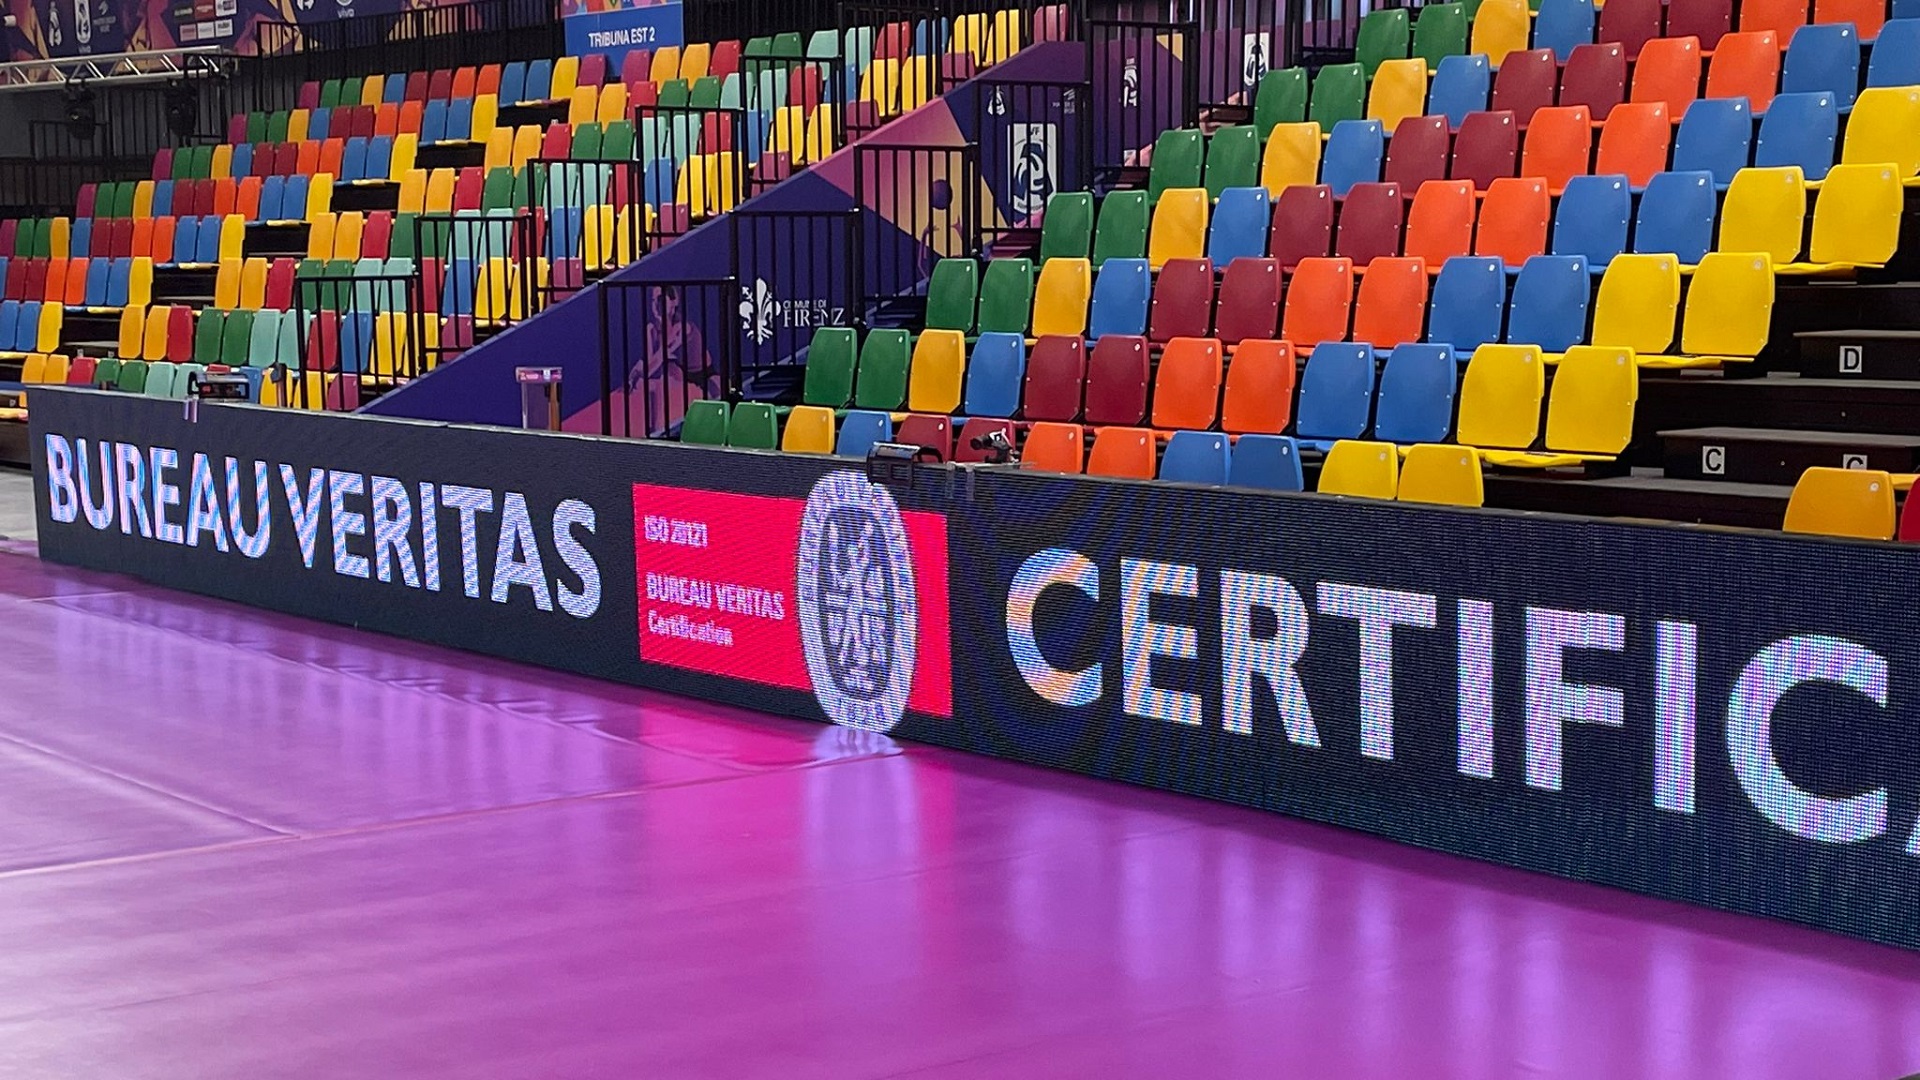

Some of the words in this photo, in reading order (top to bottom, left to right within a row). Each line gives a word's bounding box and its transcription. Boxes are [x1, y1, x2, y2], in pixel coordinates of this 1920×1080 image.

[588, 29, 630, 47] TRIBUNA
[631, 27, 648, 43] EST
[649, 26, 655, 42] 2
[783, 307, 846, 327] FIRENZ
[1843, 348, 1860, 370] D
[1705, 448, 1722, 472] C
[45, 433, 272, 559] BUREAU
[278, 463, 601, 619] VERITAS
[644, 515, 669, 543] ISO
[646, 571, 712, 609] BUREAU
[714, 582, 786, 620] VERITAS
[648, 609, 733, 647] Certification
[1006, 548, 1920, 856] CERTIFIC
